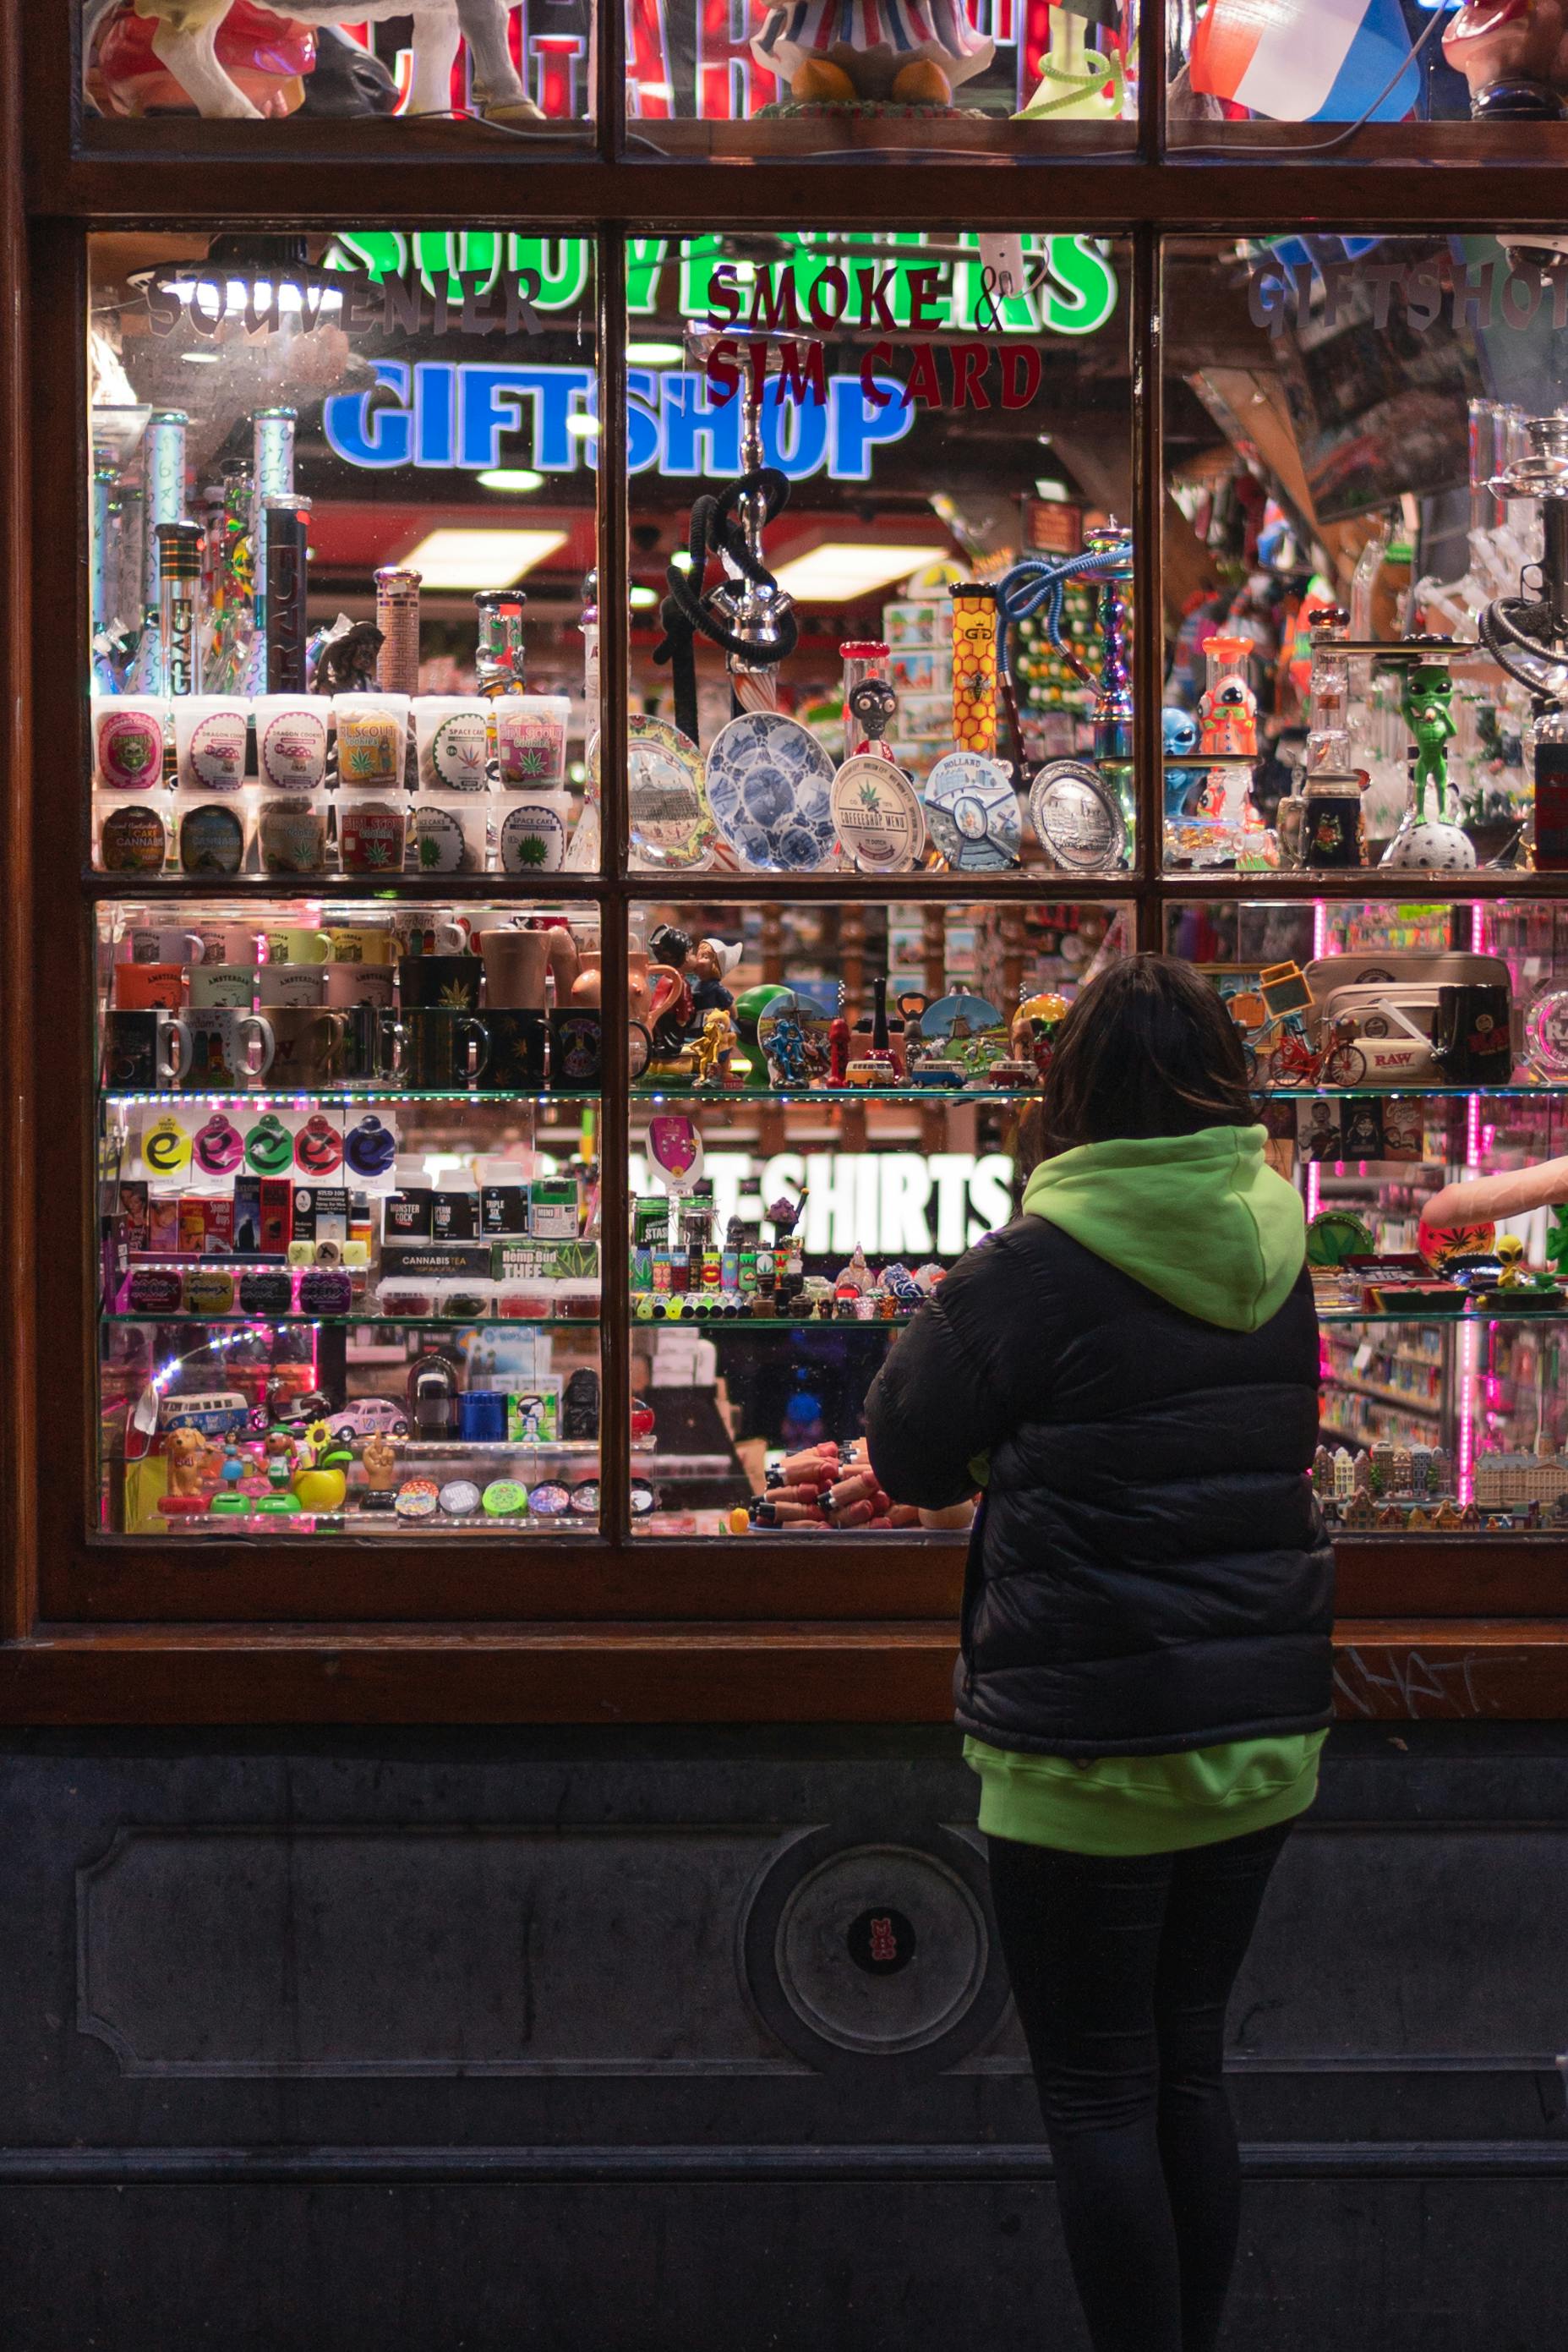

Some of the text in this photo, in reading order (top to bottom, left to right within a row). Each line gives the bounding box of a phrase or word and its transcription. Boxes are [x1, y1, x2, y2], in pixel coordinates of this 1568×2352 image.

[147, 267, 543, 336] SOUVENIER
[707, 264, 1004, 333] SMOKE &
[707, 340, 1042, 410] SIM CARD
[324, 359, 915, 480] GIFTSHOP
[172, 599, 193, 695] GRACE
[944, 758, 981, 769] HOLLAND
[841, 812, 904, 829] COFFEESHOP MENU
[208, 974, 249, 985] AMSTERDAM
[1374, 1053, 1413, 1066] RAW
[390, 1204, 420, 1213] MONSTER
[486, 1201, 505, 1209] TRIPLE
[703, 1152, 1014, 1255] T-SHIRTS
[395, 1213, 412, 1222] COCK
[646, 1228, 669, 1240] STAS
[402, 1256, 450, 1265] CANNABIS
[502, 1250, 556, 1263] Hemp Bud
[502, 1264, 541, 1278] THEE
